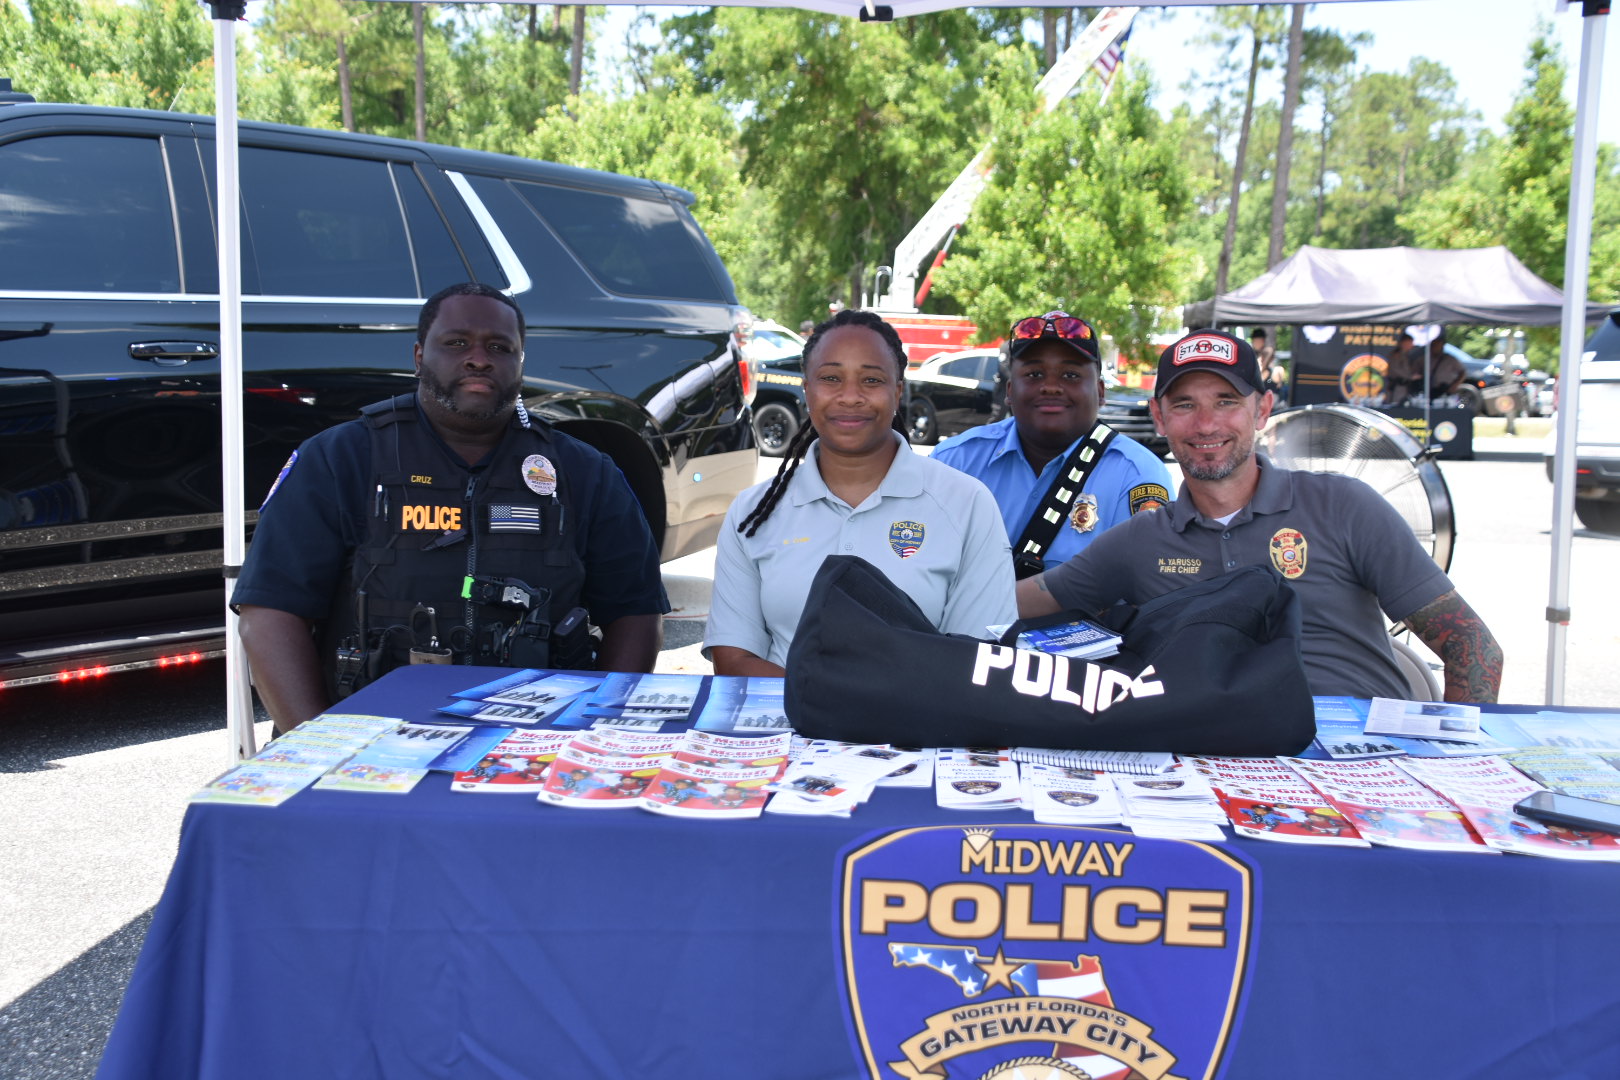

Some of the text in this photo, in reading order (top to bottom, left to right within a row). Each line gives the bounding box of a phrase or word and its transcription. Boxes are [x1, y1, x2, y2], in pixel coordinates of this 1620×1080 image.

[1344, 334, 1398, 346] PATROL
[1180, 343, 1229, 355] STATION
[410, 475, 432, 484] CRUZ
[1132, 487, 1146, 498] FIRE
[402, 505, 462, 530] POLICE
[894, 522, 924, 532] POLICE
[1168, 558, 1202, 566] YARUSSO
[961, 839, 1134, 877] MIDWAY
[860, 878, 1228, 947] POLICE
[952, 1001, 1128, 1028] NORTH FLORIDA'S
[920, 1016, 1158, 1064] GATEWAY CITY
